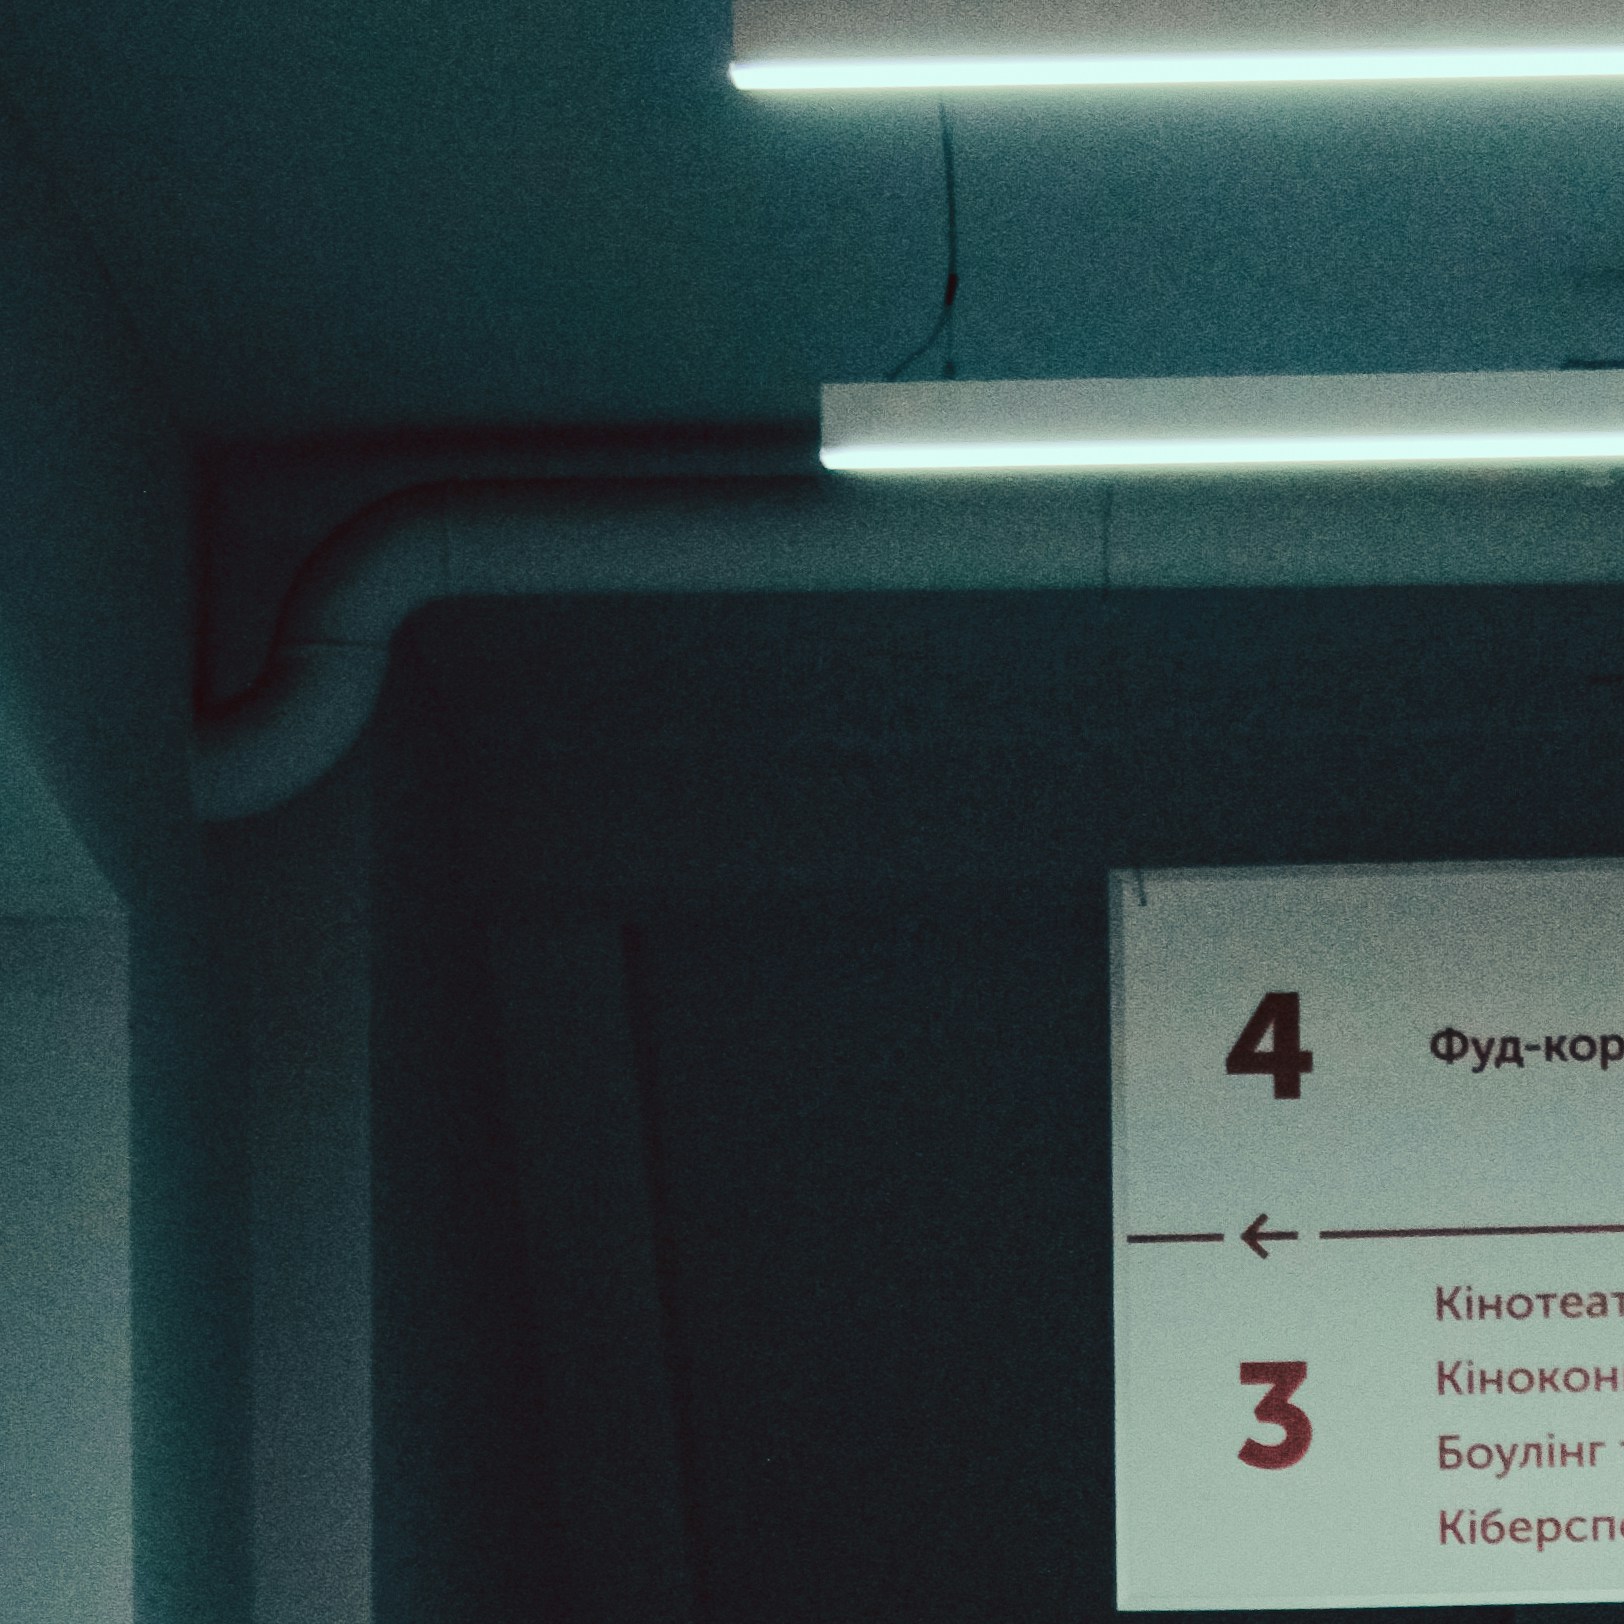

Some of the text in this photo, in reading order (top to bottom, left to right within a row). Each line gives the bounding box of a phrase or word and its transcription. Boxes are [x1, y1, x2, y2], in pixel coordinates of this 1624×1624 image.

[1224, 989, 1315, 1101] 4
[1236, 1359, 1314, 1471] 3
[1437, 1432, 1606, 1480] Боулінг
